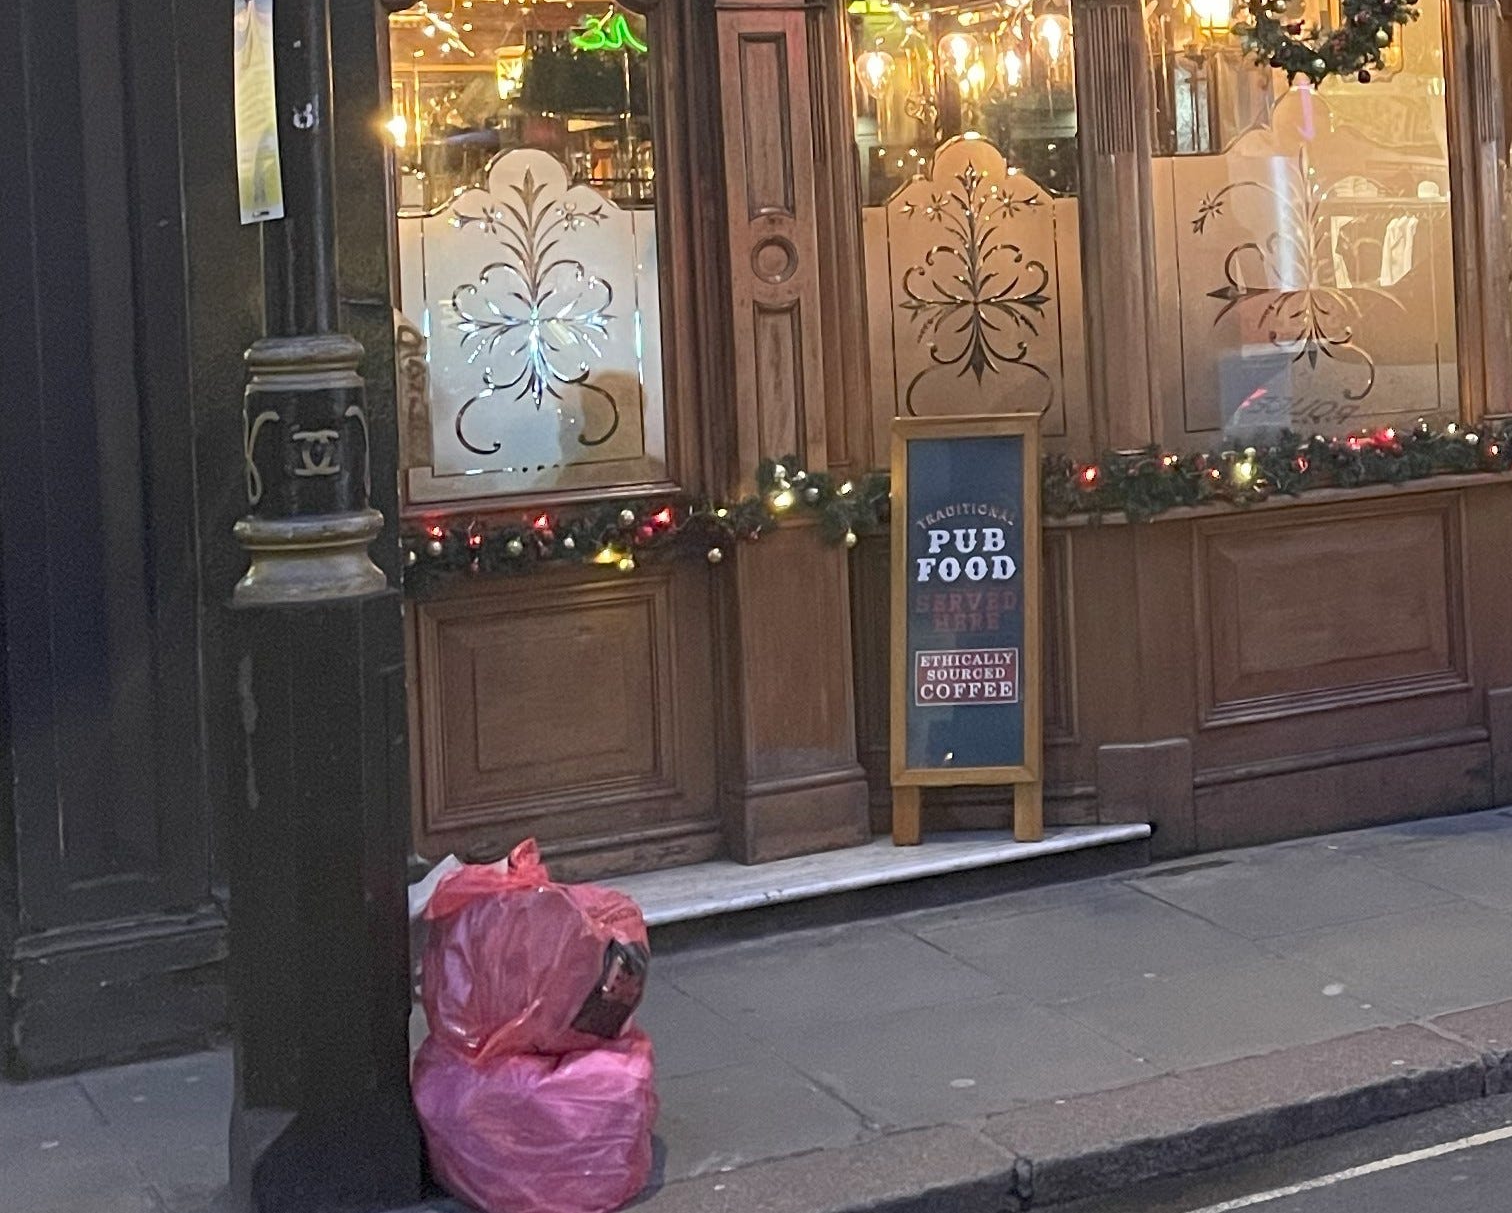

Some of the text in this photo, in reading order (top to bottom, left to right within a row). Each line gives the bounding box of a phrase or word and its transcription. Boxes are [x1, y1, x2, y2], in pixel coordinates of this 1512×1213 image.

[928, 528, 1006, 554] PUB
[917, 555, 1017, 582] FOOD
[915, 590, 1018, 614] SERVED
[920, 652, 1014, 668] ETHICALLY
[927, 668, 1006, 682] SOURCED
[920, 681, 1013, 700] COFFEE
